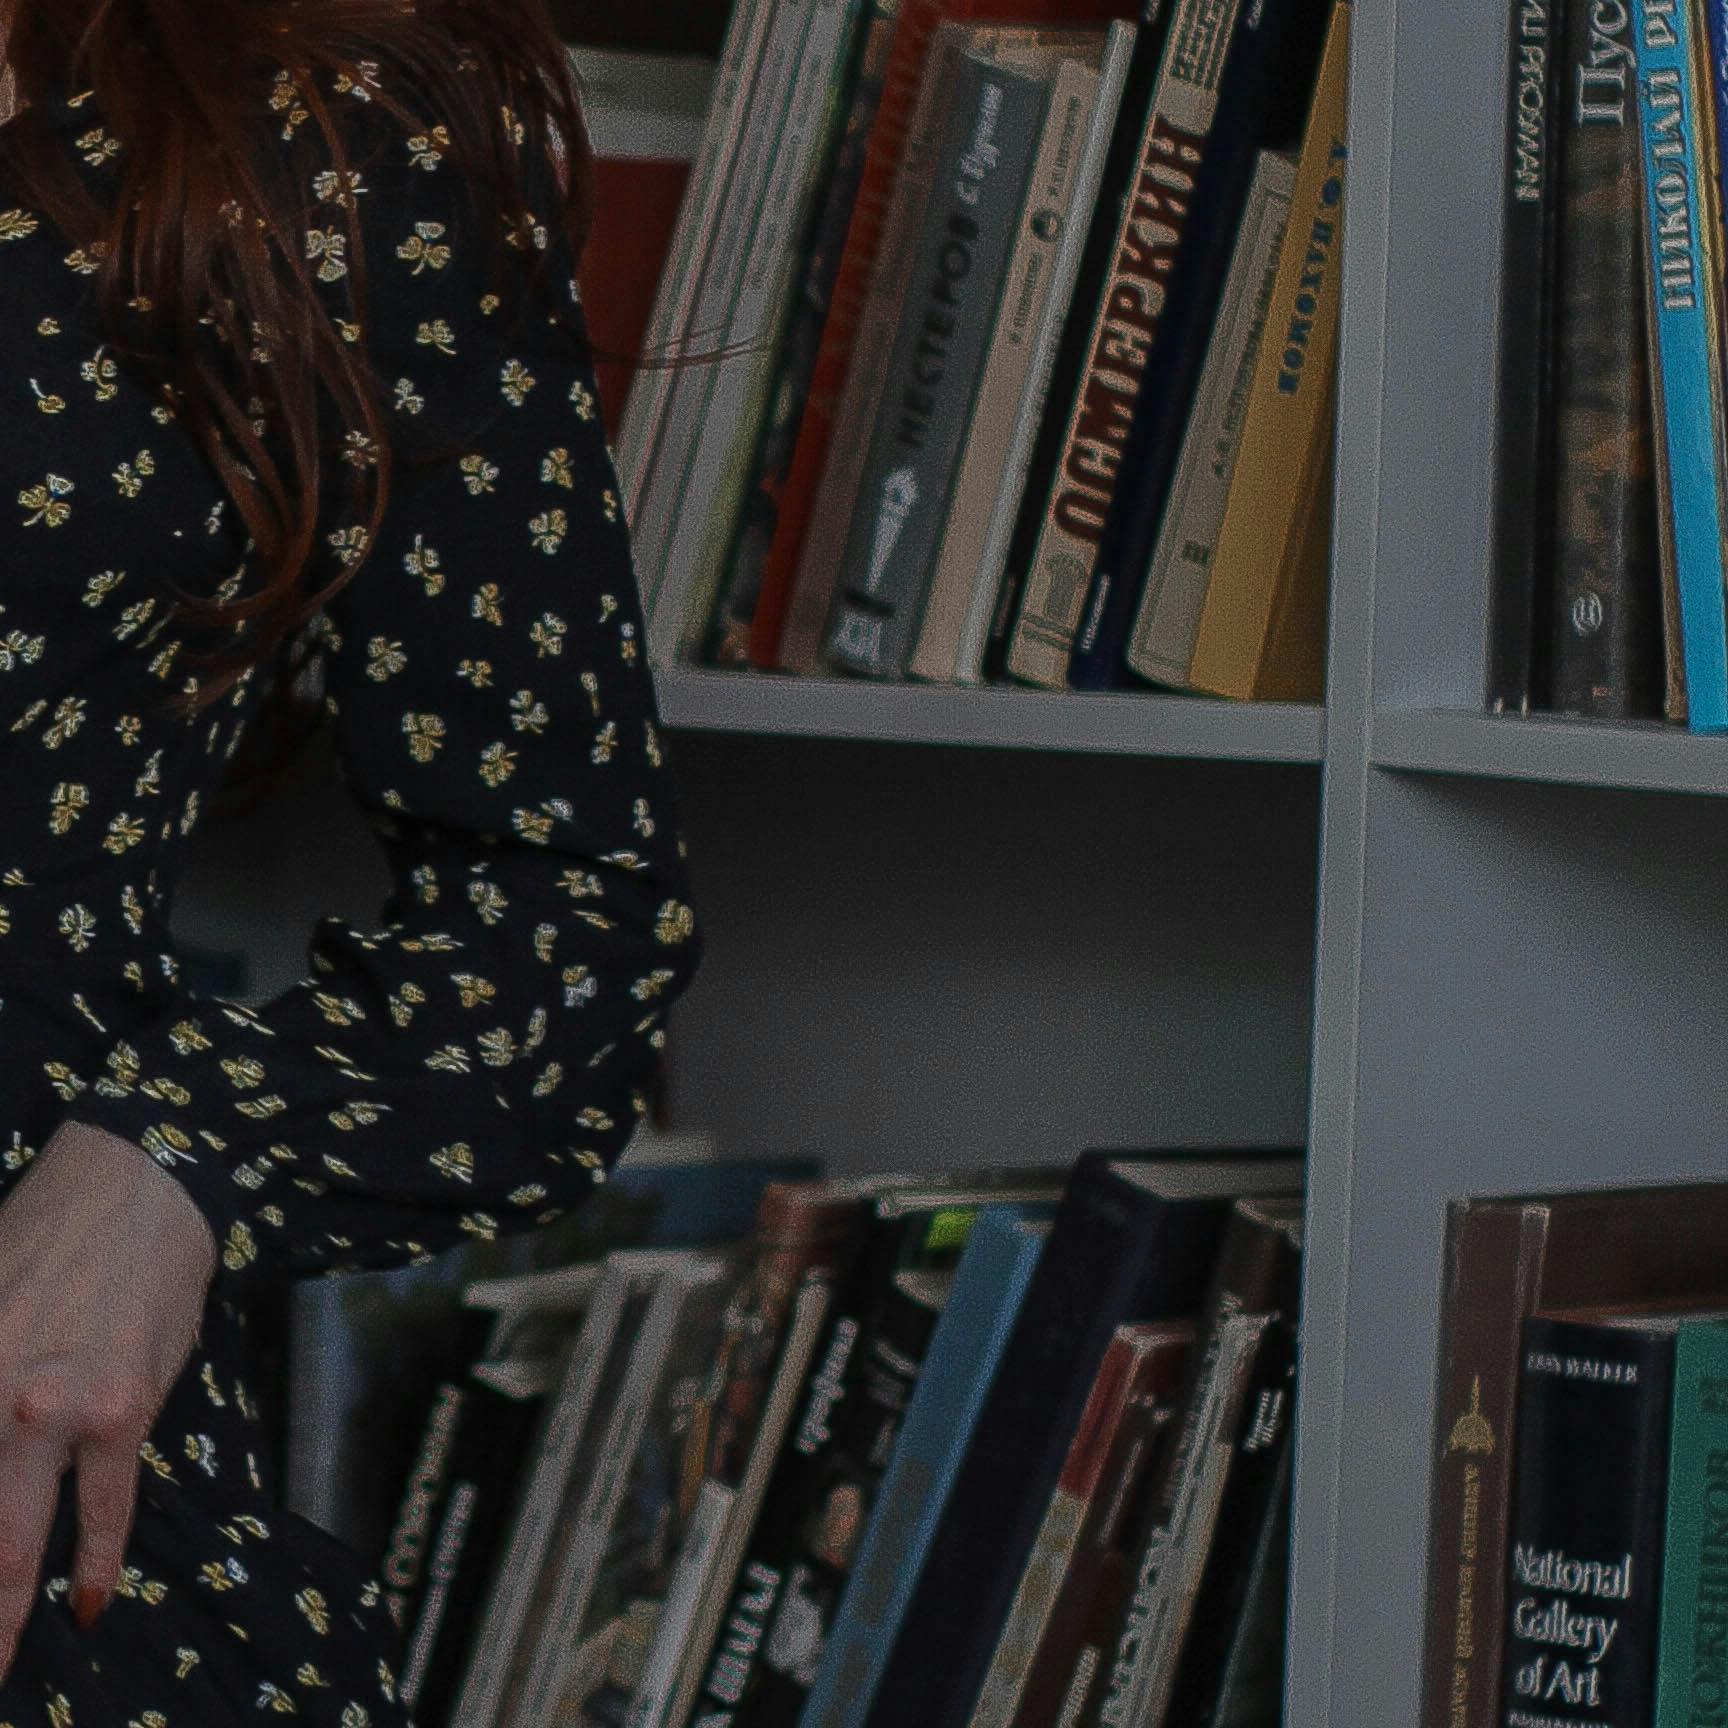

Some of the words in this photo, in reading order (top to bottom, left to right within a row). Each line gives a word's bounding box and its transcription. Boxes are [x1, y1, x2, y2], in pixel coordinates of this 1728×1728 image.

[1638, 67, 1696, 313] НИКОЛАЙ
[894, 211, 979, 455] НЕСТЕРОВ
[1035, 116, 1216, 547] ОСМЕРКИН
[1512, 1540, 1633, 1601] National
[1512, 1596, 1618, 1666] Gallery
[1514, 1654, 1543, 1700] of
[1544, 1664, 1602, 1708] Art
